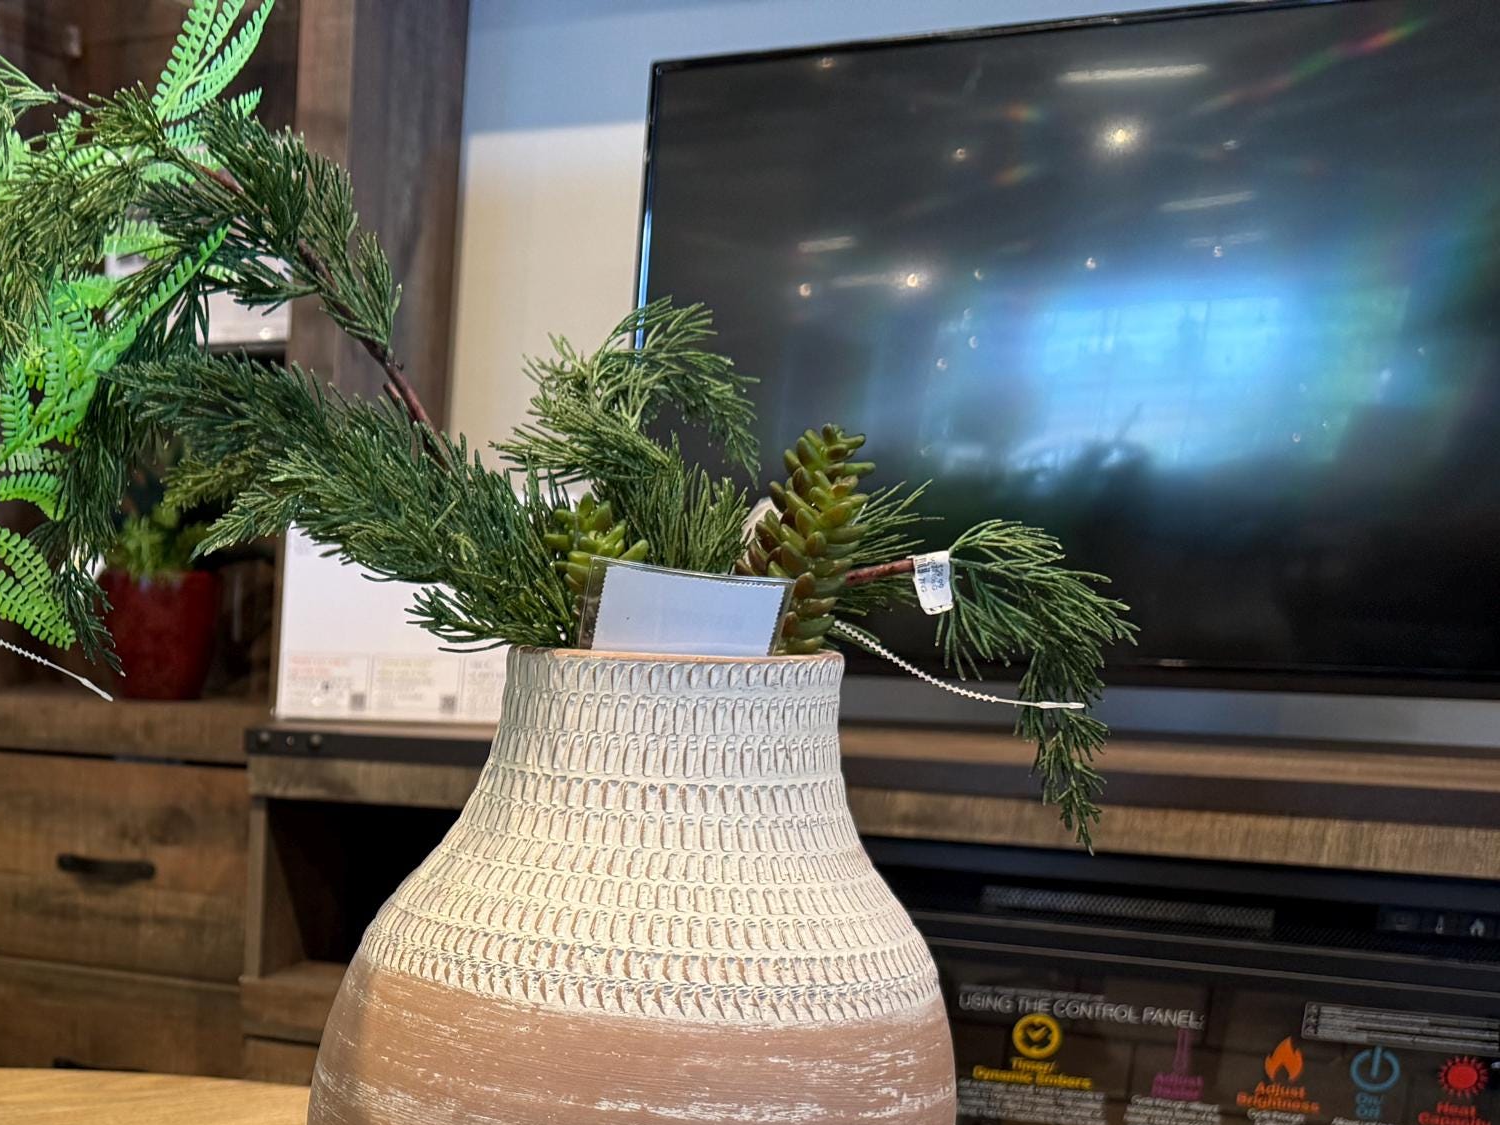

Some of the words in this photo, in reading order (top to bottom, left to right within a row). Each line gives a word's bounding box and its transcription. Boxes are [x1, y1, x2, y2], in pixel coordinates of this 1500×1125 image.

[958, 992, 1016, 1014] USING
[1017, 996, 1052, 1013] THE
[1053, 998, 1141, 1024] CONTROL
[1254, 1080, 1308, 1099] Adjust
[1236, 1091, 1322, 1115] Brightness
[1435, 1100, 1477, 1118] Heat
